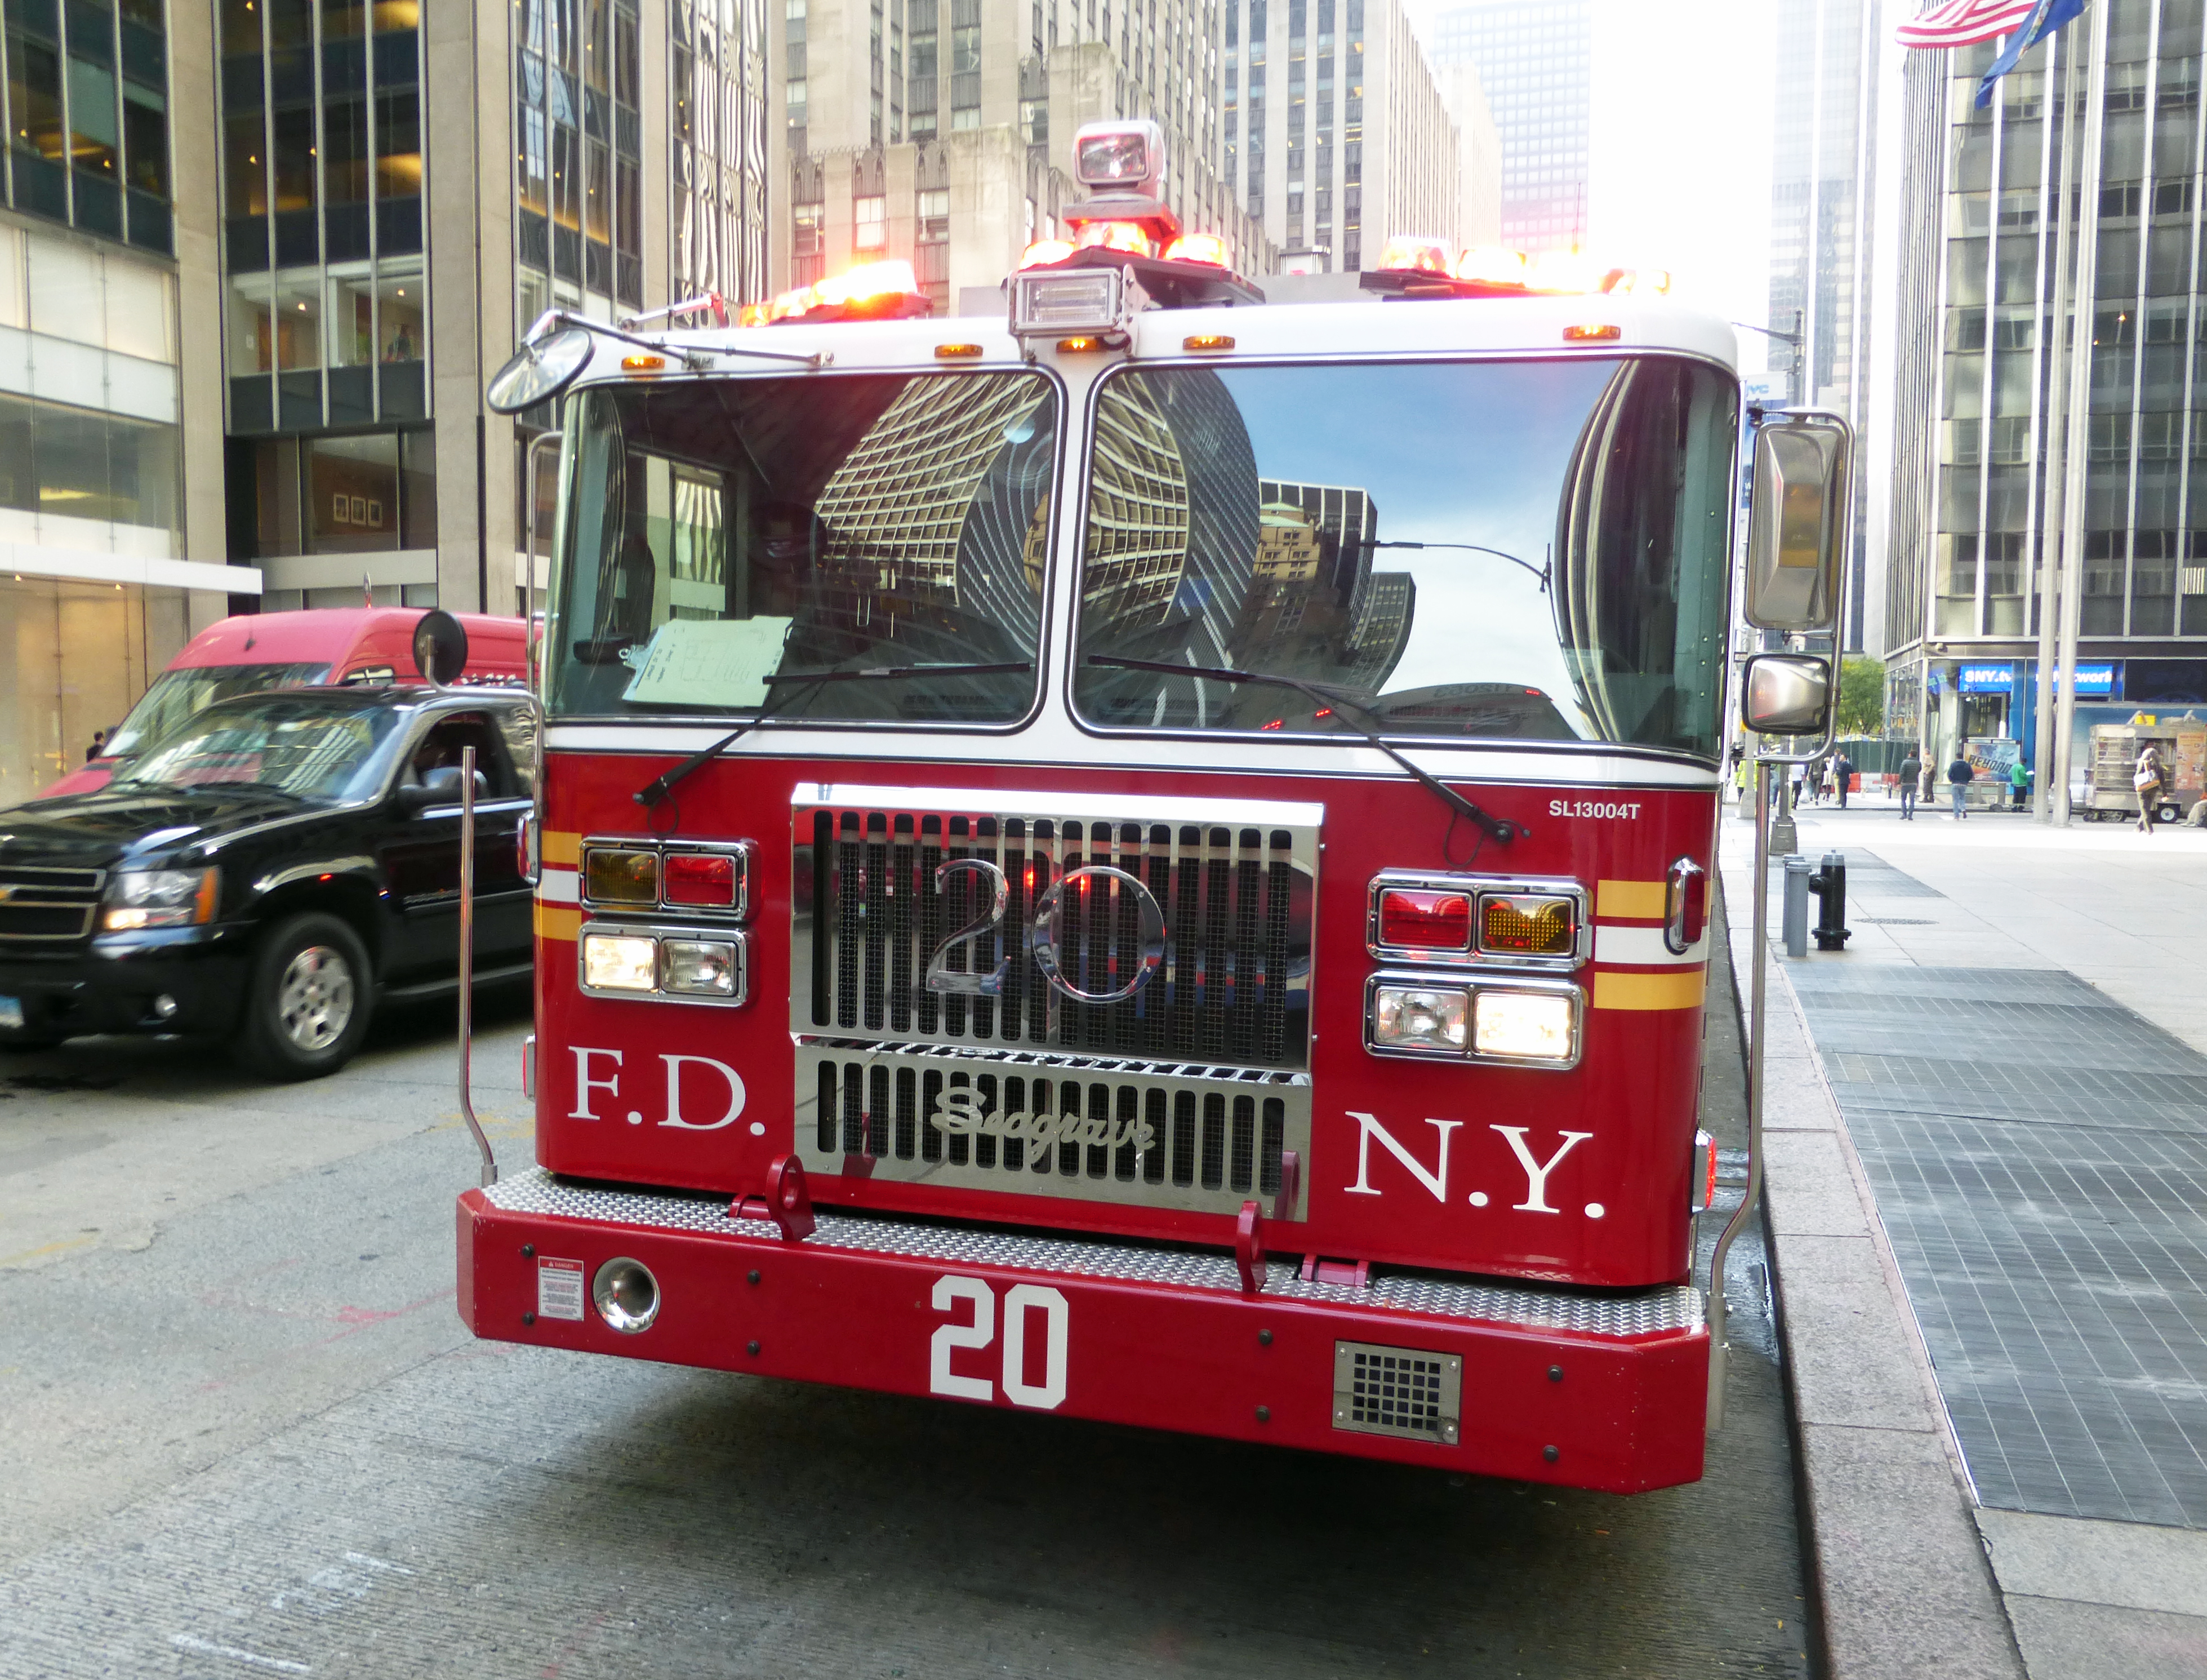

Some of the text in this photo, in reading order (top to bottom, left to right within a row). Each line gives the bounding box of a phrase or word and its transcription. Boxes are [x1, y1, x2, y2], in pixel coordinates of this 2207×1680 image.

[2053, 670, 2112, 683] Nwork
[1549, 800, 1641, 819] SL13004T
[926, 859, 1166, 1004] 20
[567, 1045, 766, 1136] F.D.
[930, 1086, 1156, 1164] Seagrave
[1343, 1110, 1605, 1219] N.Y.
[930, 1274, 1069, 1410] 20
